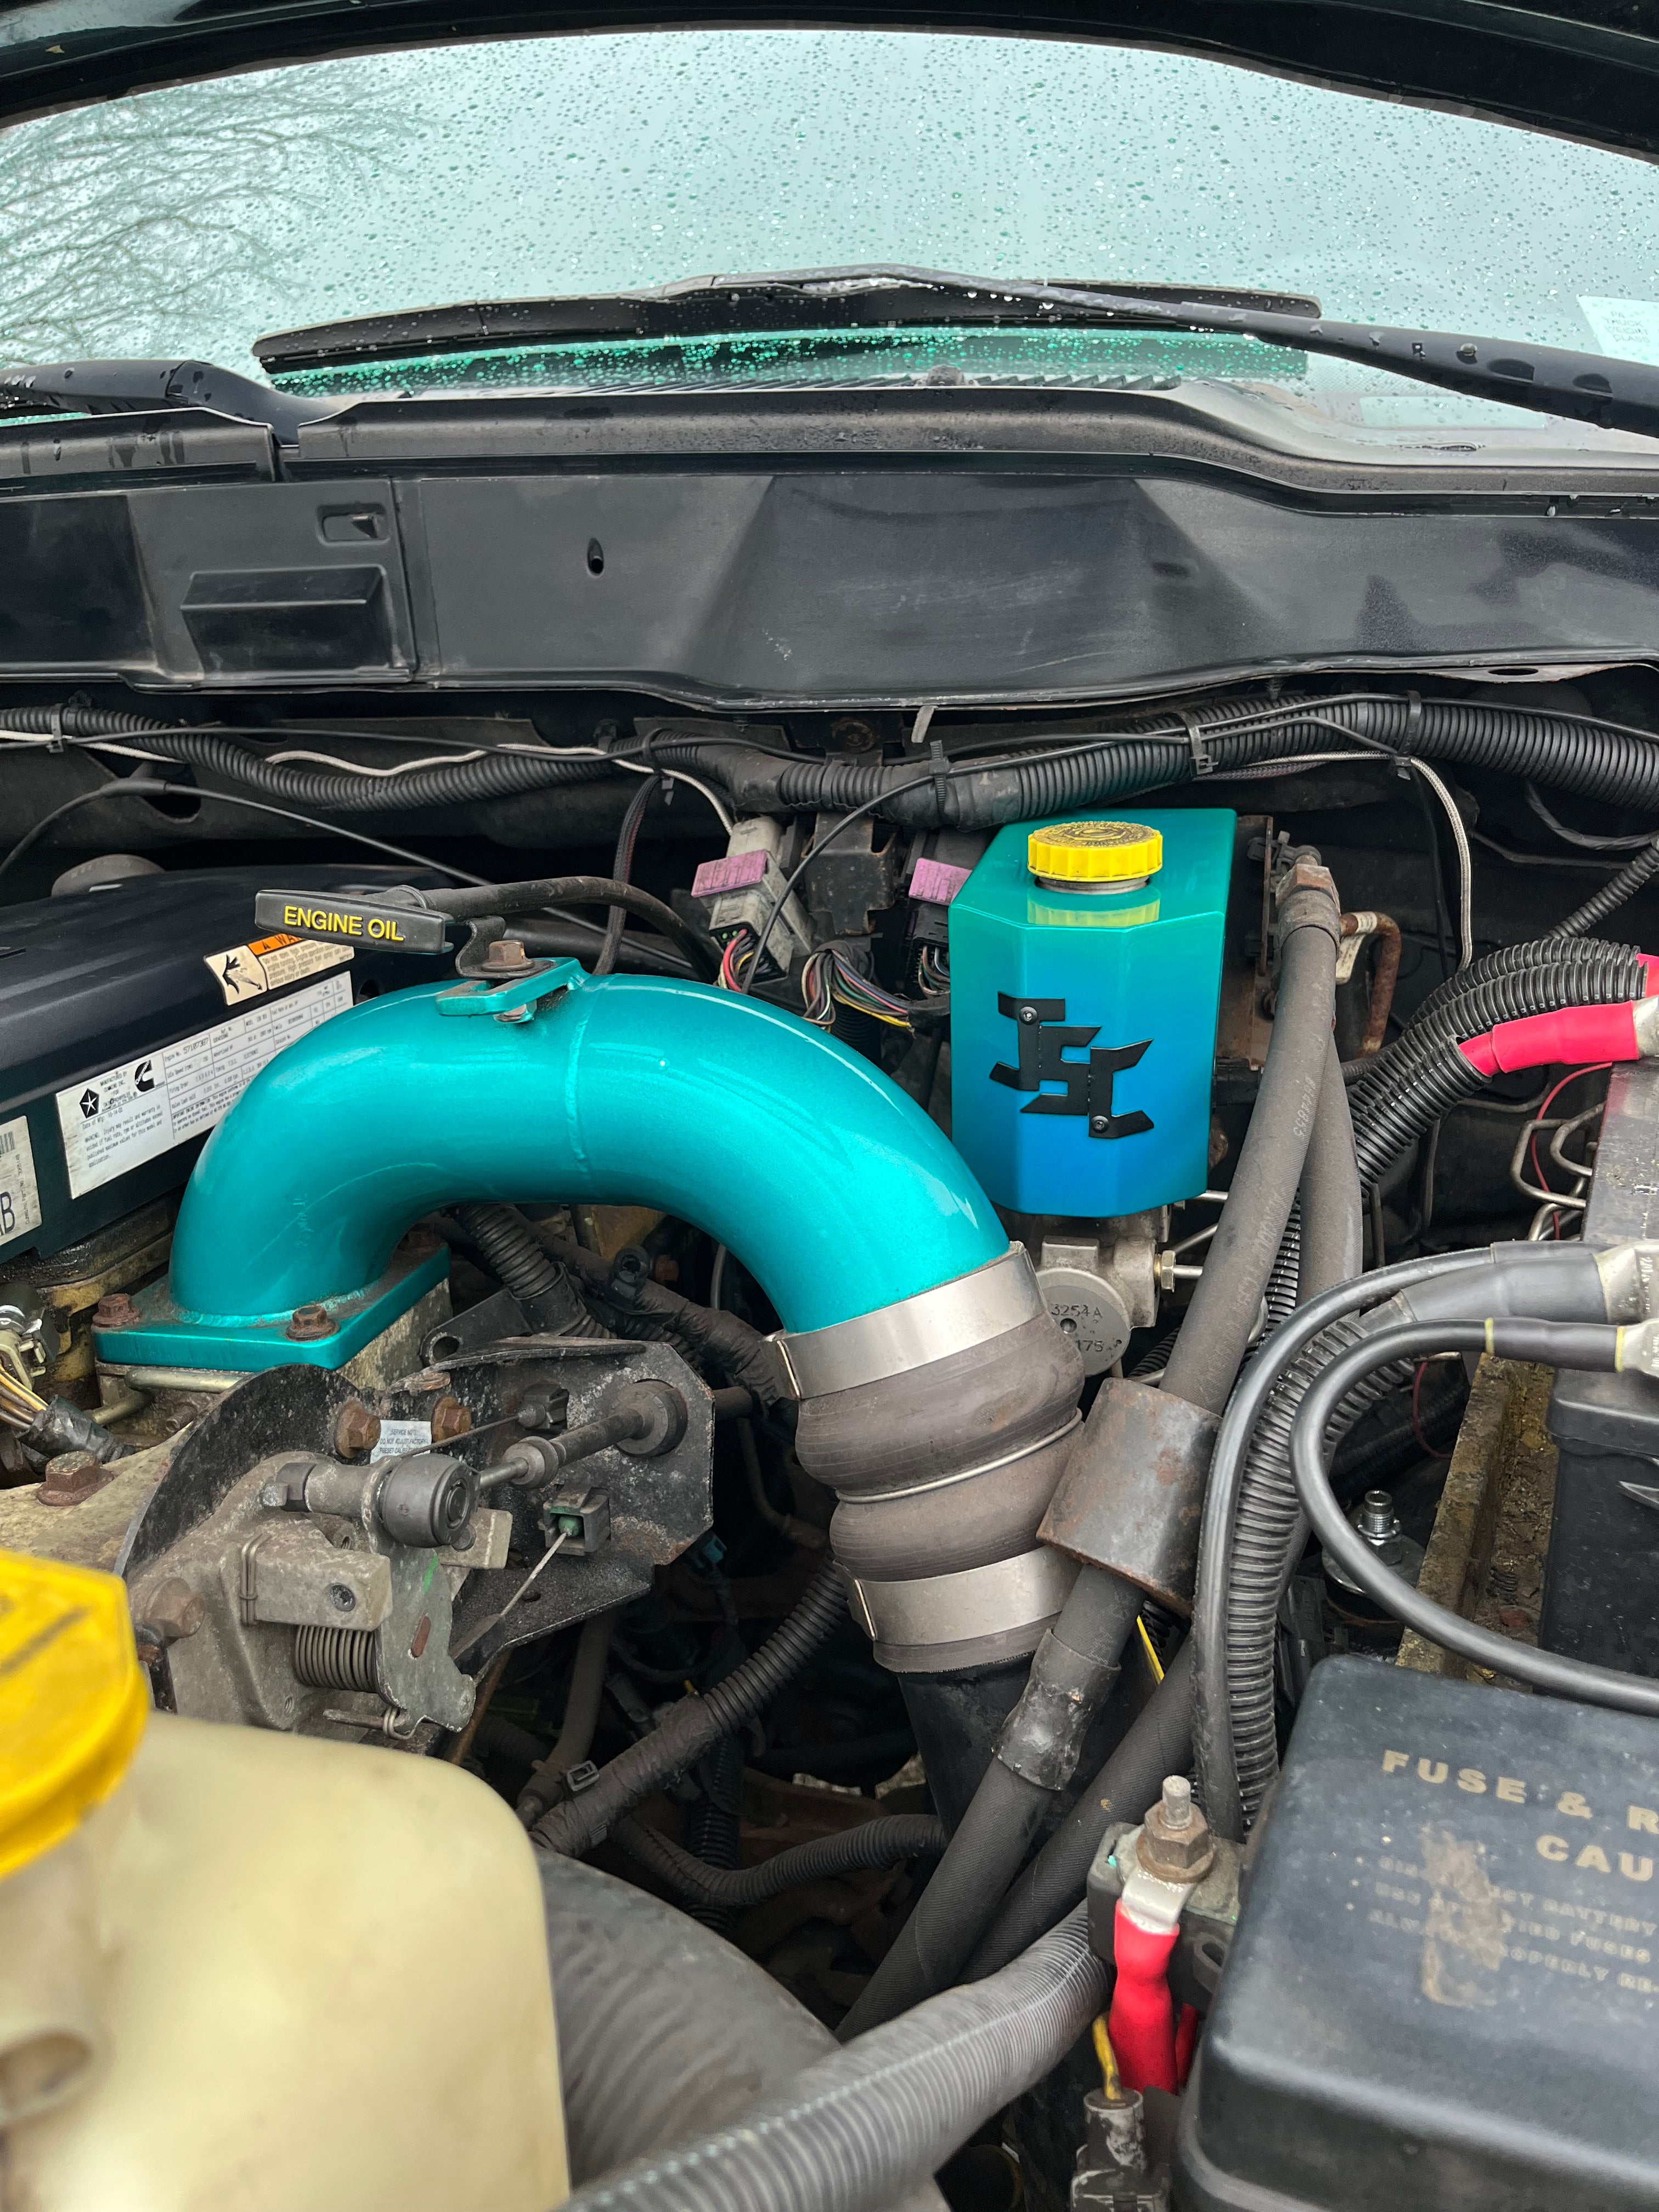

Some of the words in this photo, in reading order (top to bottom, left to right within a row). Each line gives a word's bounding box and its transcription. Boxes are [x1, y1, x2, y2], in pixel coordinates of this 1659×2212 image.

[284, 905, 363, 935] ENGINE
[367, 918, 405, 942] OIL
[0, 1190, 15, 1234] B
[1382, 1750, 1527, 1804] FUSE
[1556, 1791, 1593, 1820] &
